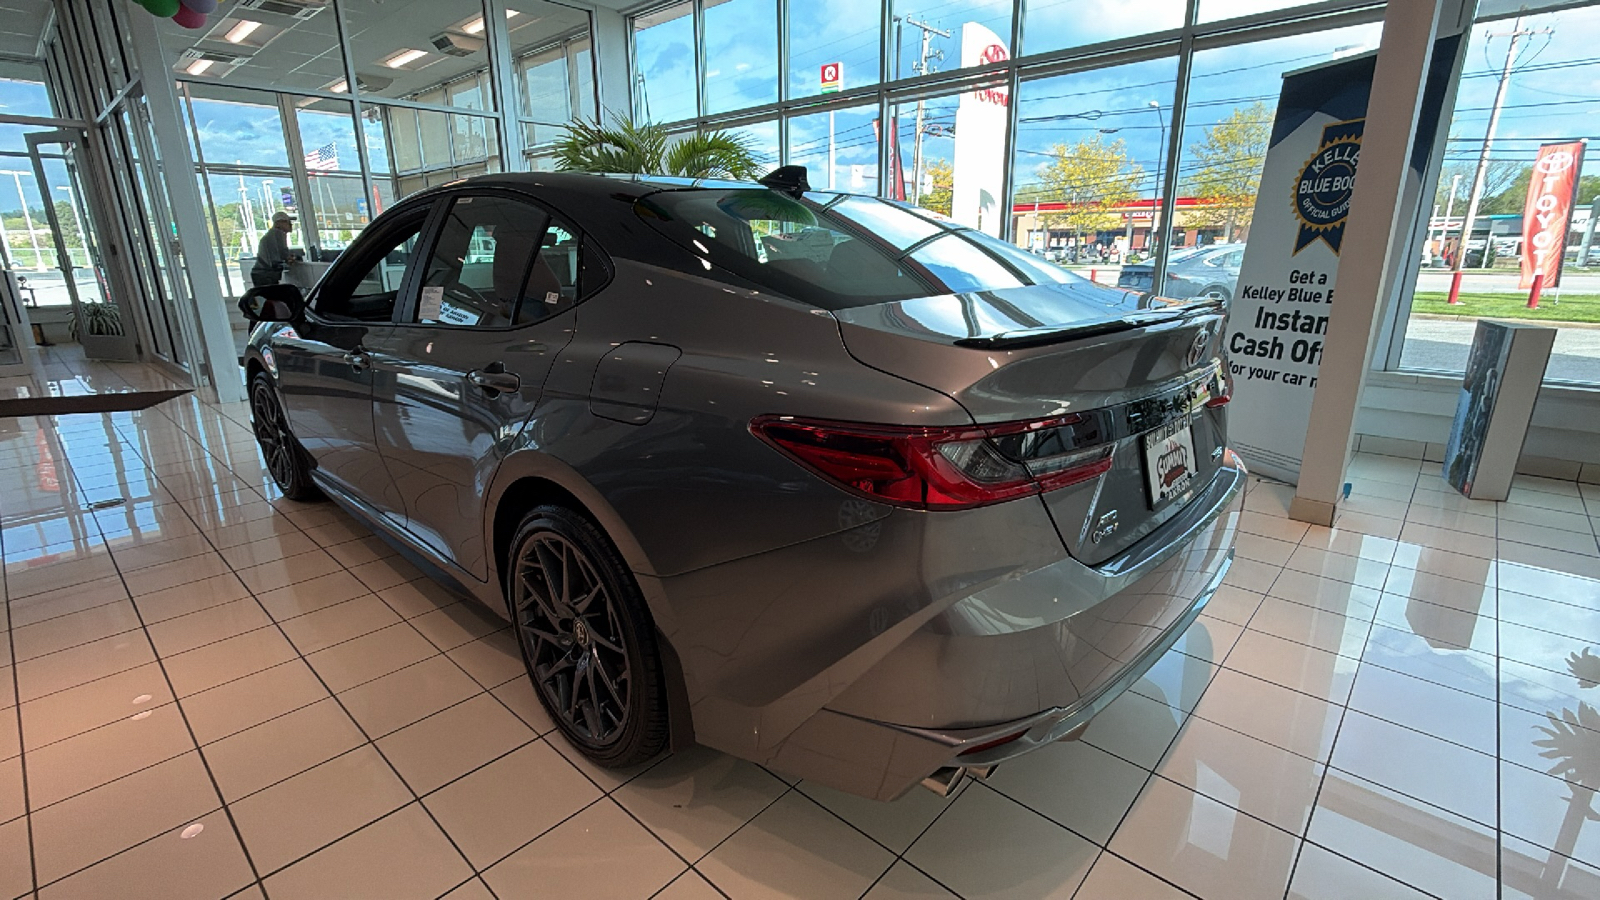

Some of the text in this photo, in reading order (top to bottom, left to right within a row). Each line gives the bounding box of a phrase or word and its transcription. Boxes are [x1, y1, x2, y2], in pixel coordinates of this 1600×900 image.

[1312, 146, 1360, 173] KELLE
[1300, 175, 1356, 194] BLUE BOO
[1302, 198, 1350, 219] OFFICIAL GUID
[1289, 269, 1328, 285] Get a
[1241, 285, 1286, 304] Kelley
[1287, 288, 1322, 304] Blue
[1254, 306, 1329, 335] Instan
[1229, 332, 1284, 361] Cash
[1247, 366, 1280, 381] your
[1282, 372, 1307, 386] car
[1167, 479, 1191, 501] AKRON
